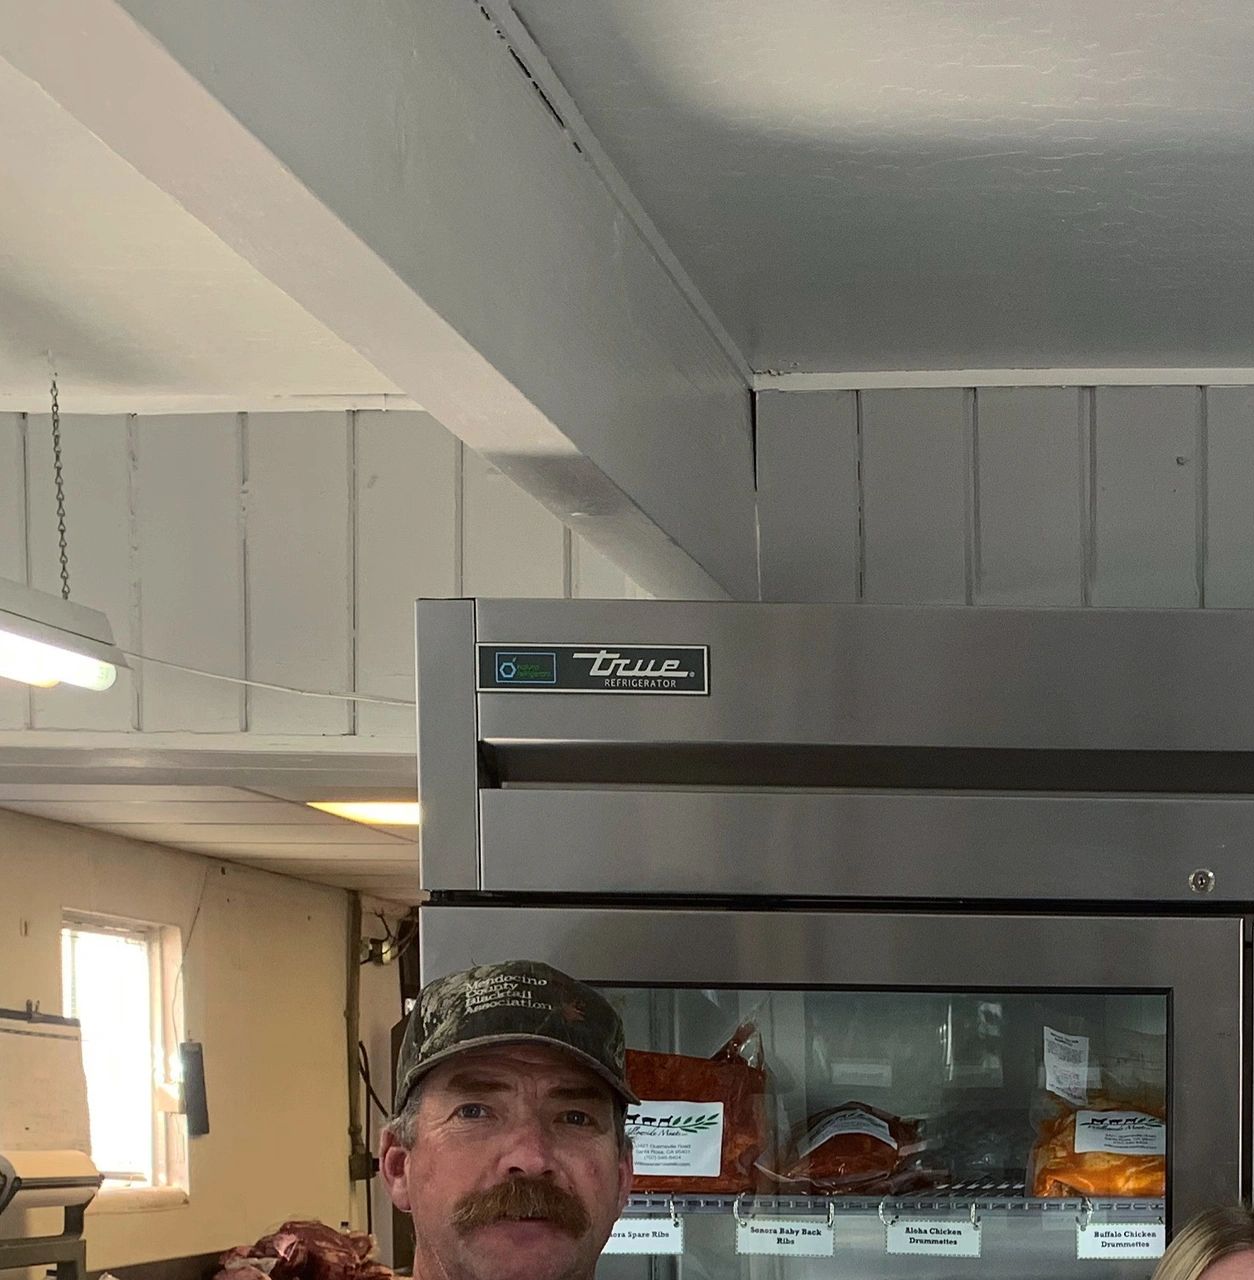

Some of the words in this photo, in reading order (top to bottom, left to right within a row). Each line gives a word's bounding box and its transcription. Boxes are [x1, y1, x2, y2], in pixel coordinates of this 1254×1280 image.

[604, 678, 677, 688] REFRIGERATOR
[465, 974, 548, 991] Mendocino
[465, 982, 518, 998] County
[463, 998, 552, 1017] Association
[627, 1231, 650, 1240] Spare
[750, 1226, 778, 1234] Sonora
[779, 1227, 800, 1237] Baby
[801, 1228, 822, 1236] Back
[905, 1226, 928, 1234] Aloha
[929, 1227, 962, 1236] Chicken
[1093, 1230, 1122, 1238] Buffalo
[1123, 1230, 1157, 1238] Chicken
[776, 1237, 795, 1245] Ribs
[909, 1236, 958, 1245] Drummettes
[1101, 1240, 1150, 1248] Drummettes
